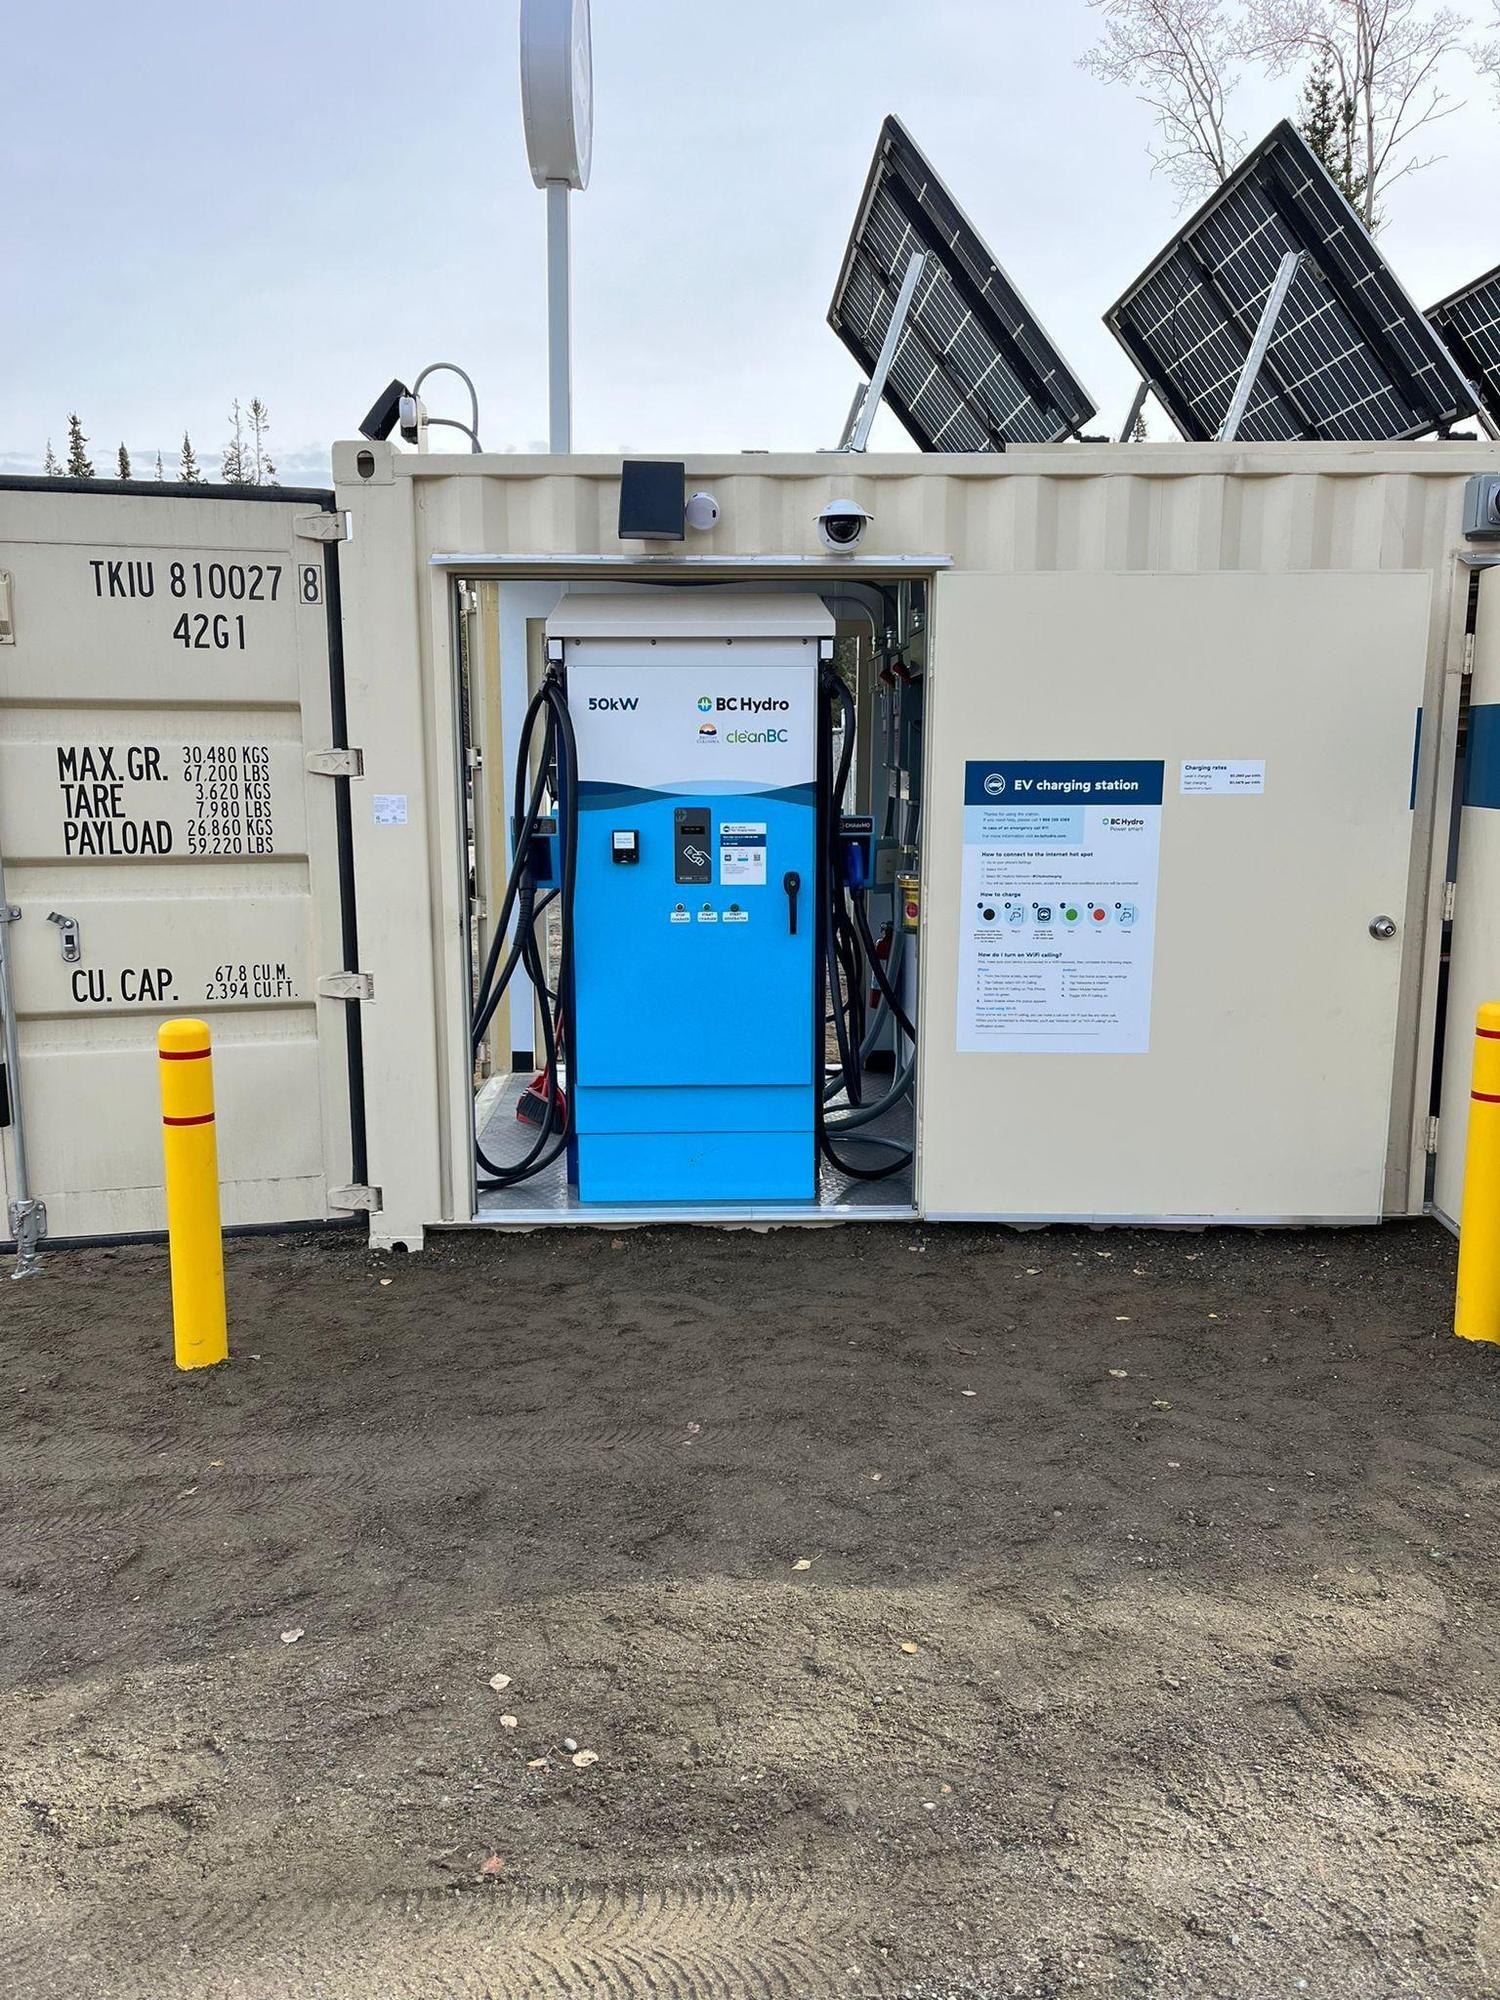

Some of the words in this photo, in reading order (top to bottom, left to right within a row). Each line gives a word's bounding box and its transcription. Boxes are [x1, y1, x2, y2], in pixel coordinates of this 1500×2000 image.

[89, 560, 155, 598] TKIU
[170, 562, 283, 601] 810027
[303, 566, 319, 602] 8
[173, 612, 246, 650] 42G1
[588, 697, 639, 711] 50kW
[716, 697, 737, 711] BC
[740, 697, 789, 714] Hydro
[183, 746, 237, 764] 30,480
[243, 746, 269, 764] KGS
[184, 764, 238, 783] 67,200
[243, 764, 270, 782] LBS
[245, 783, 271, 800] KGS
[1014, 780, 1033, 791] EV
[1036, 780, 1091, 793] charging
[1094, 779, 1139, 791] station
[60, 783, 126, 818] TARE
[245, 801, 272, 818] LBS
[187, 819, 241, 837] 26,860
[246, 819, 273, 836] KGS
[1121, 818, 1144, 826] Hydro
[64, 820, 173, 855] PAYLOAD
[188, 837, 242, 855] 59,220
[248, 837, 274, 854] LBS
[215, 965, 247, 982] 67.8
[253, 963, 291, 981] CU.M.
[71, 969, 113, 1003] CU.
[120, 968, 179, 1002] CAP.
[254, 981, 299, 998] CU.FT.
